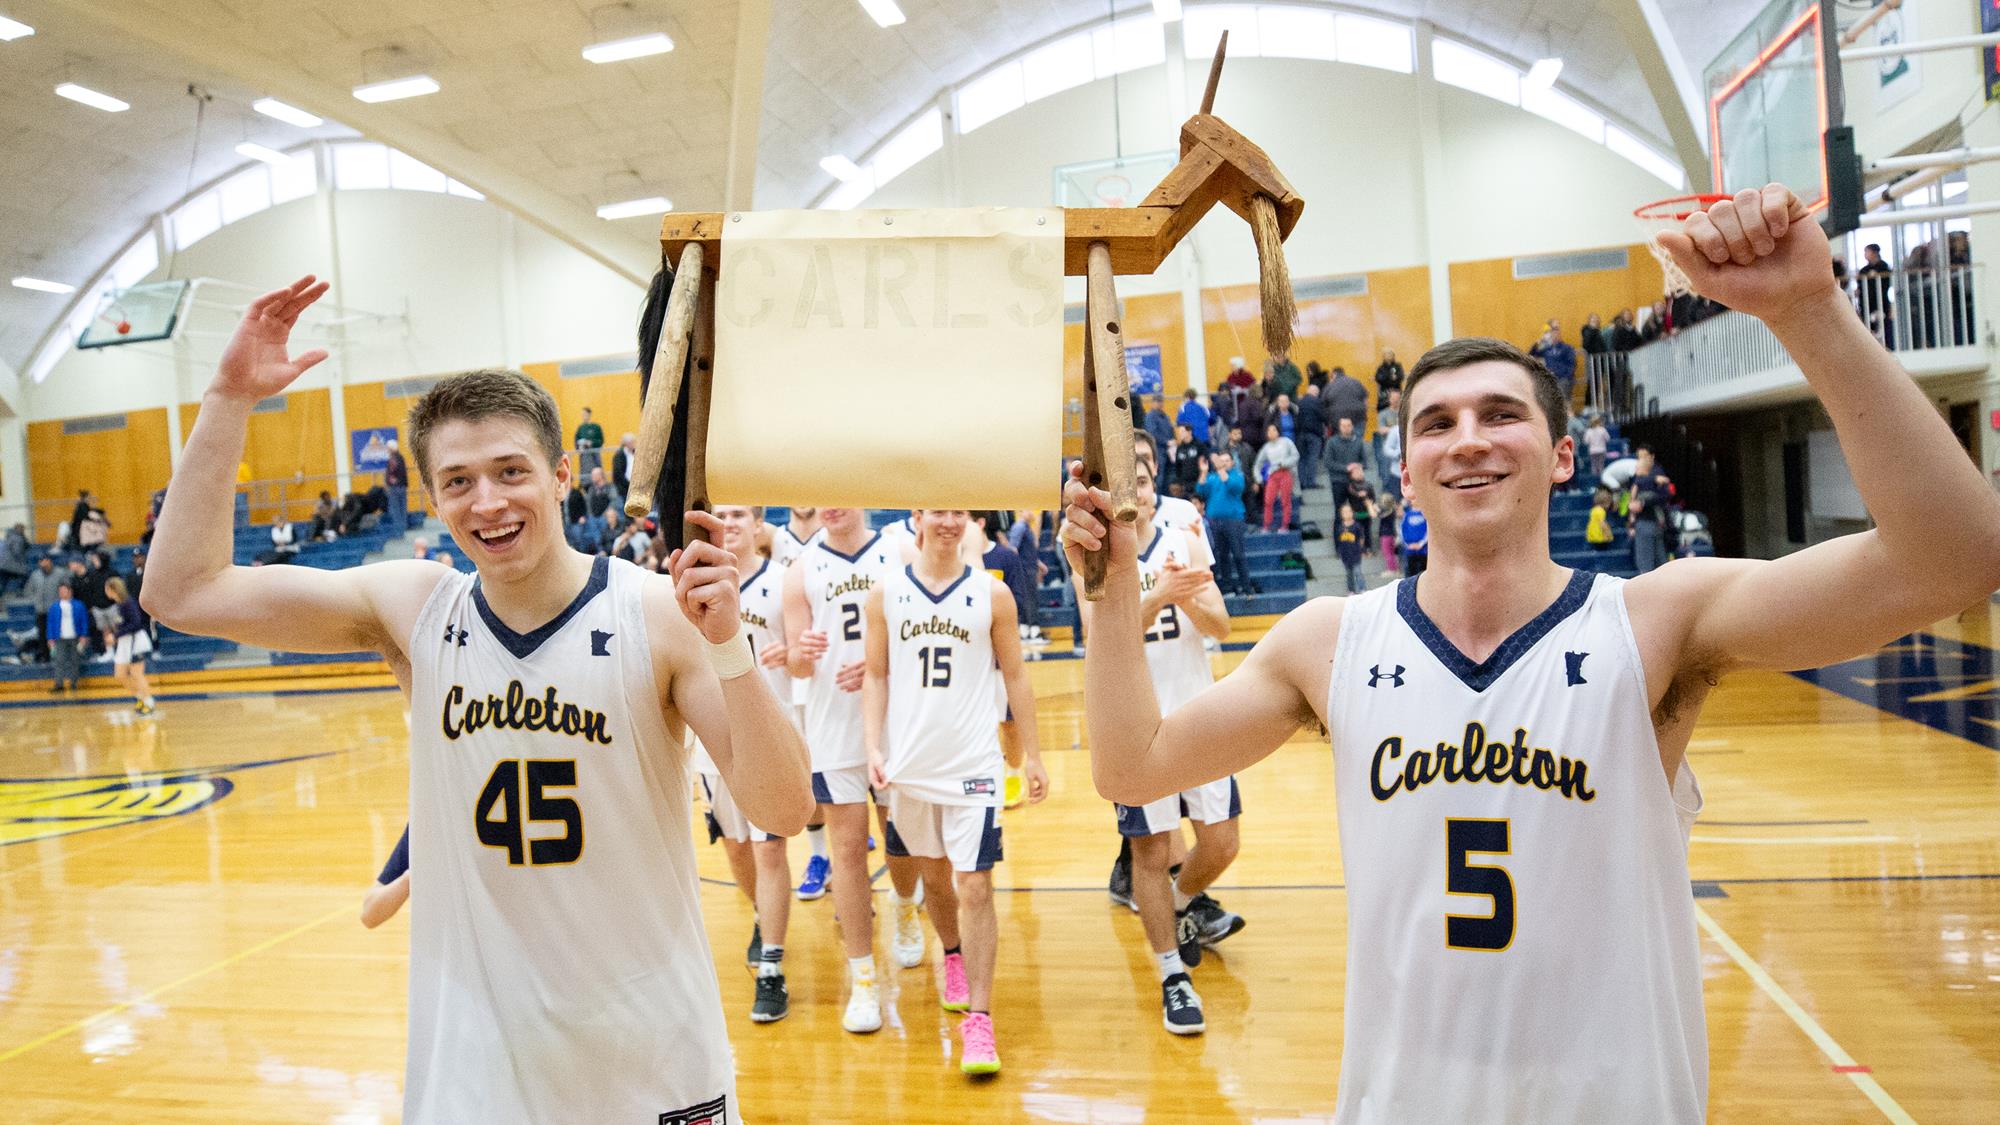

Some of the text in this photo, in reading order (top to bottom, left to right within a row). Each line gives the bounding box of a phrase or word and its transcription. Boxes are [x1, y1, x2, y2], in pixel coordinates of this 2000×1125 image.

[720, 240, 1061, 330] CARLS
[825, 573, 875, 602] Carlet
[841, 602, 862, 642] 2
[900, 615, 971, 643] Carleton
[917, 646, 952, 688] 15
[442, 679, 613, 745] Carleton
[1370, 721, 1597, 804] Carleton
[474, 758, 583, 867] 45
[1444, 816, 1518, 953] 5
